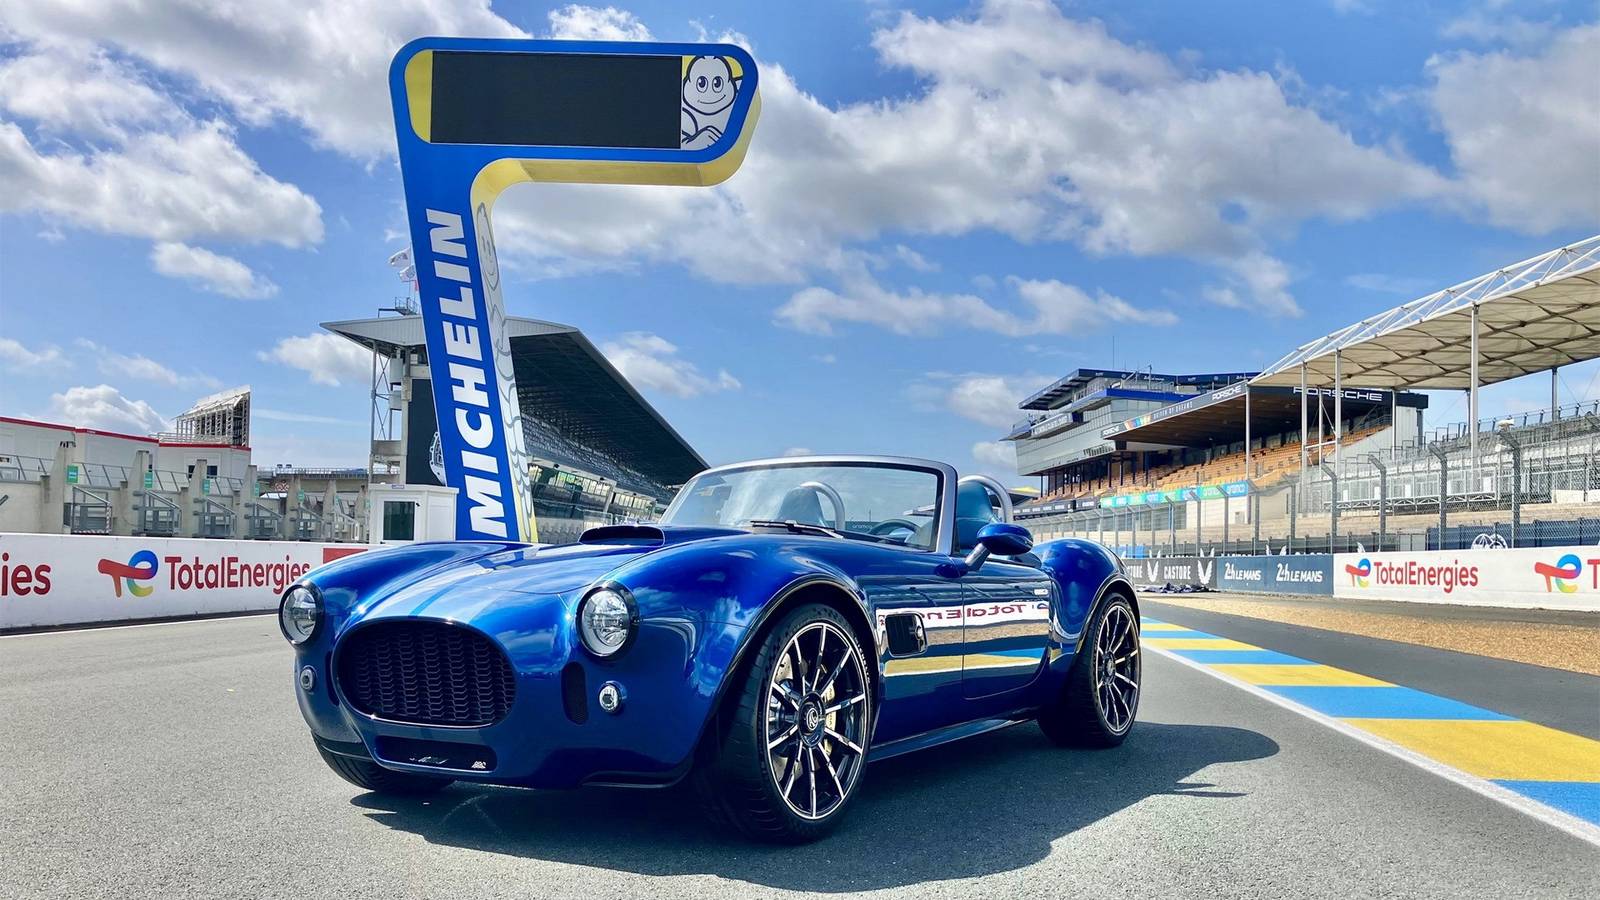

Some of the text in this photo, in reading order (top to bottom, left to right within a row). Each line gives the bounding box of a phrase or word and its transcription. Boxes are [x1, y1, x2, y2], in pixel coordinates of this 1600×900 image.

[426, 208, 508, 538] MICHELIN
[1211, 385, 1242, 401] PORSCHE
[1, 552, 51, 596] ies
[1163, 565, 1191, 580] CASTORE
[1300, 570, 1323, 583] MANS
[1374, 560, 1479, 594] TotalEnergies
